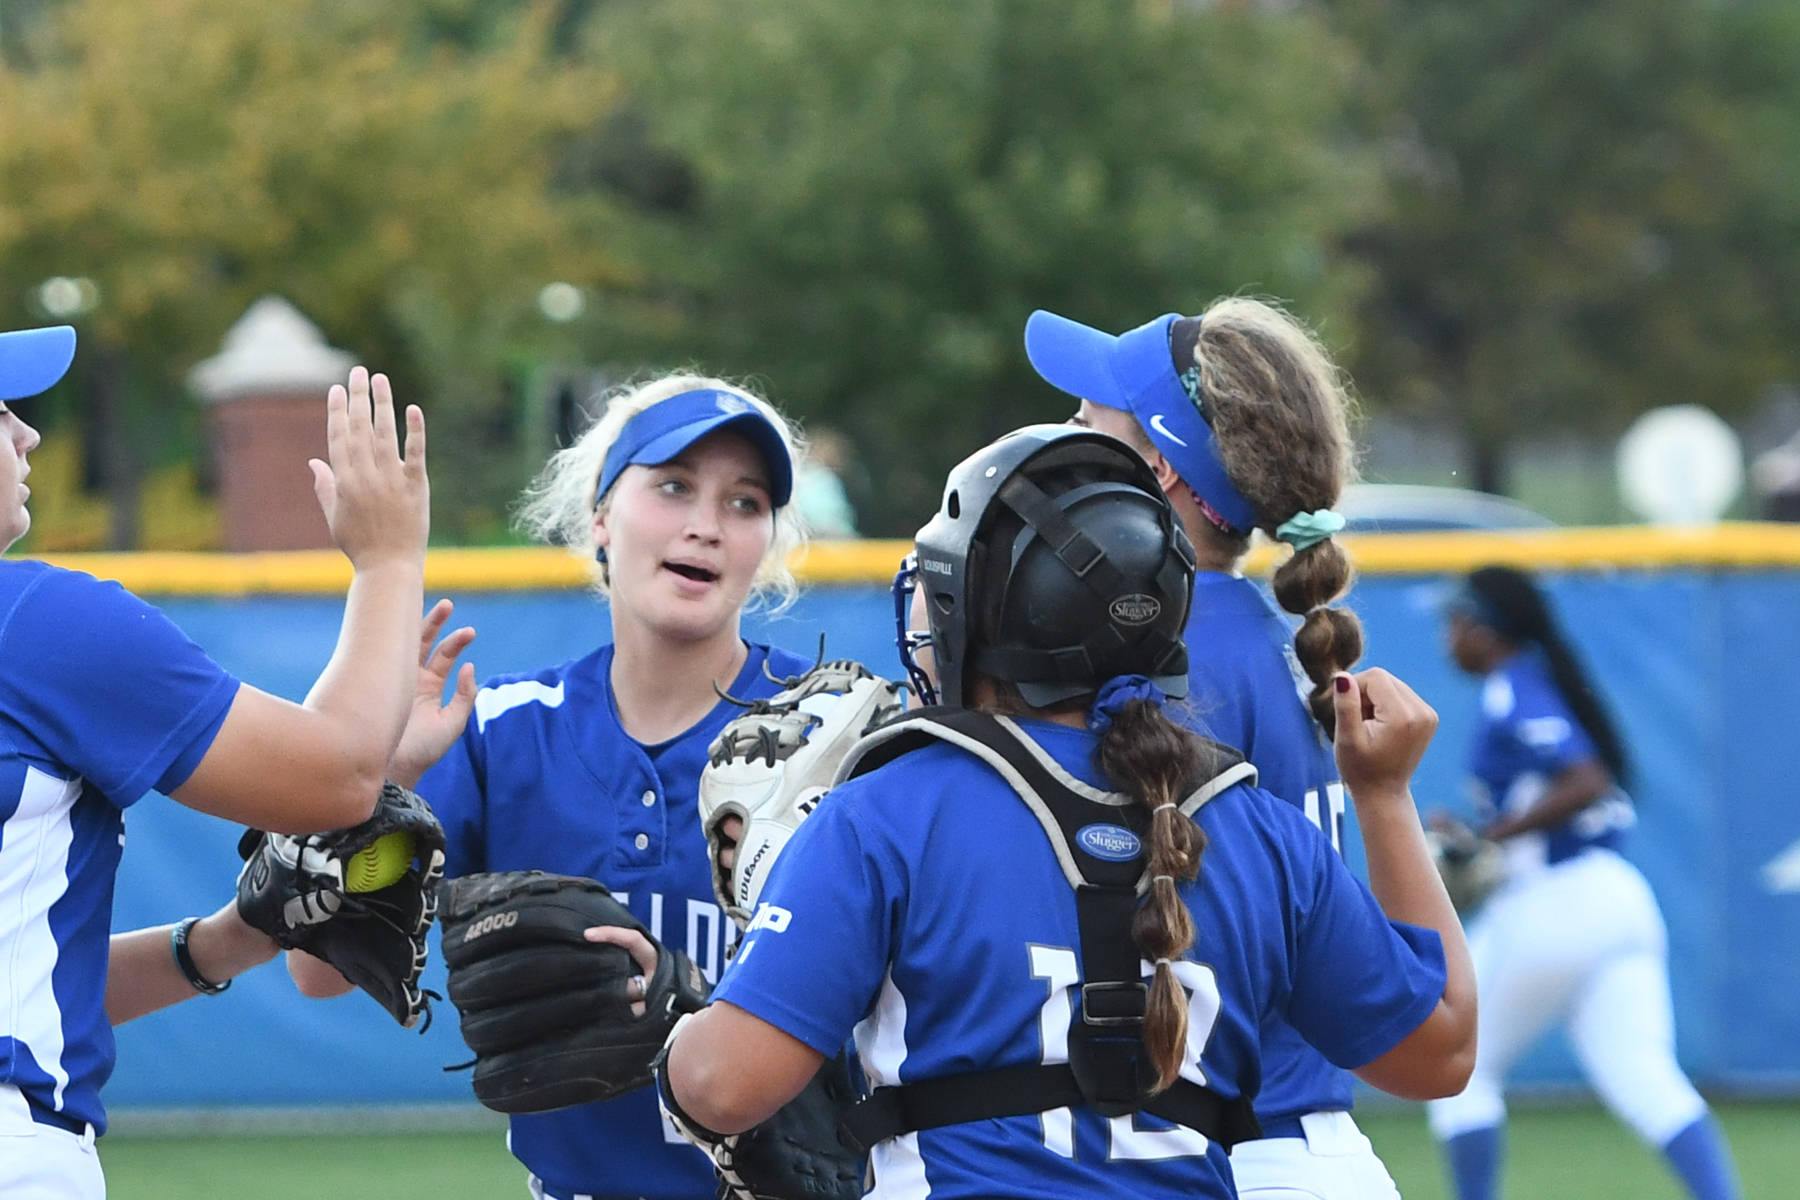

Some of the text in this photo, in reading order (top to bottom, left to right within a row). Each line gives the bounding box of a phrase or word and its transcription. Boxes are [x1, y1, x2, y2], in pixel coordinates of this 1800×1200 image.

[1088, 831, 1138, 851] Slugger
[740, 843, 770, 901] Wilson
[1026, 942, 1221, 1163] 12
